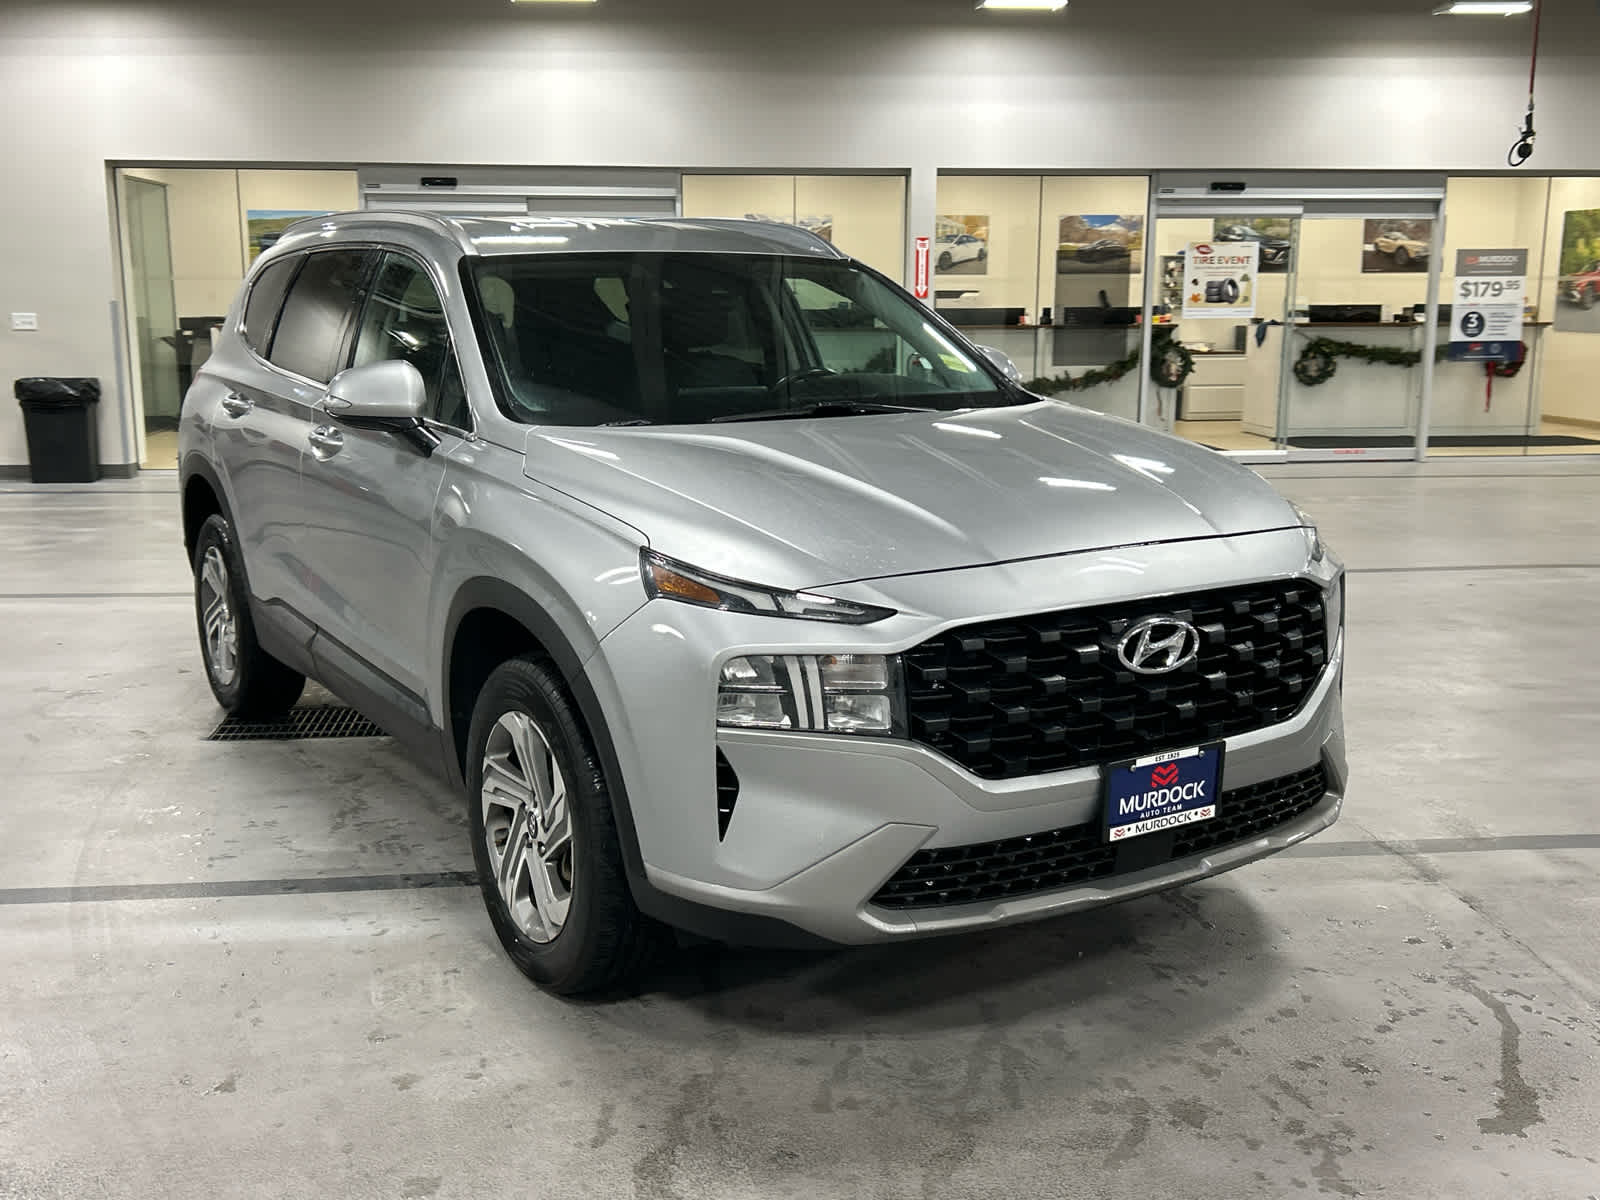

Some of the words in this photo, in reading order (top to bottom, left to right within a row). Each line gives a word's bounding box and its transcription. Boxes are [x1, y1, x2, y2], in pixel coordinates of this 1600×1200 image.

[1192, 256, 1215, 265] TIRE
[1217, 256, 1251, 265] EVENT
[1467, 313, 1479, 327] 3
[1155, 754, 1165, 762] EST
[1119, 780, 1206, 816] MURDOCK
[1140, 808, 1160, 819] AUTO
[1163, 803, 1182, 814] TEAM
[1135, 812, 1192, 834] MURDOCK
